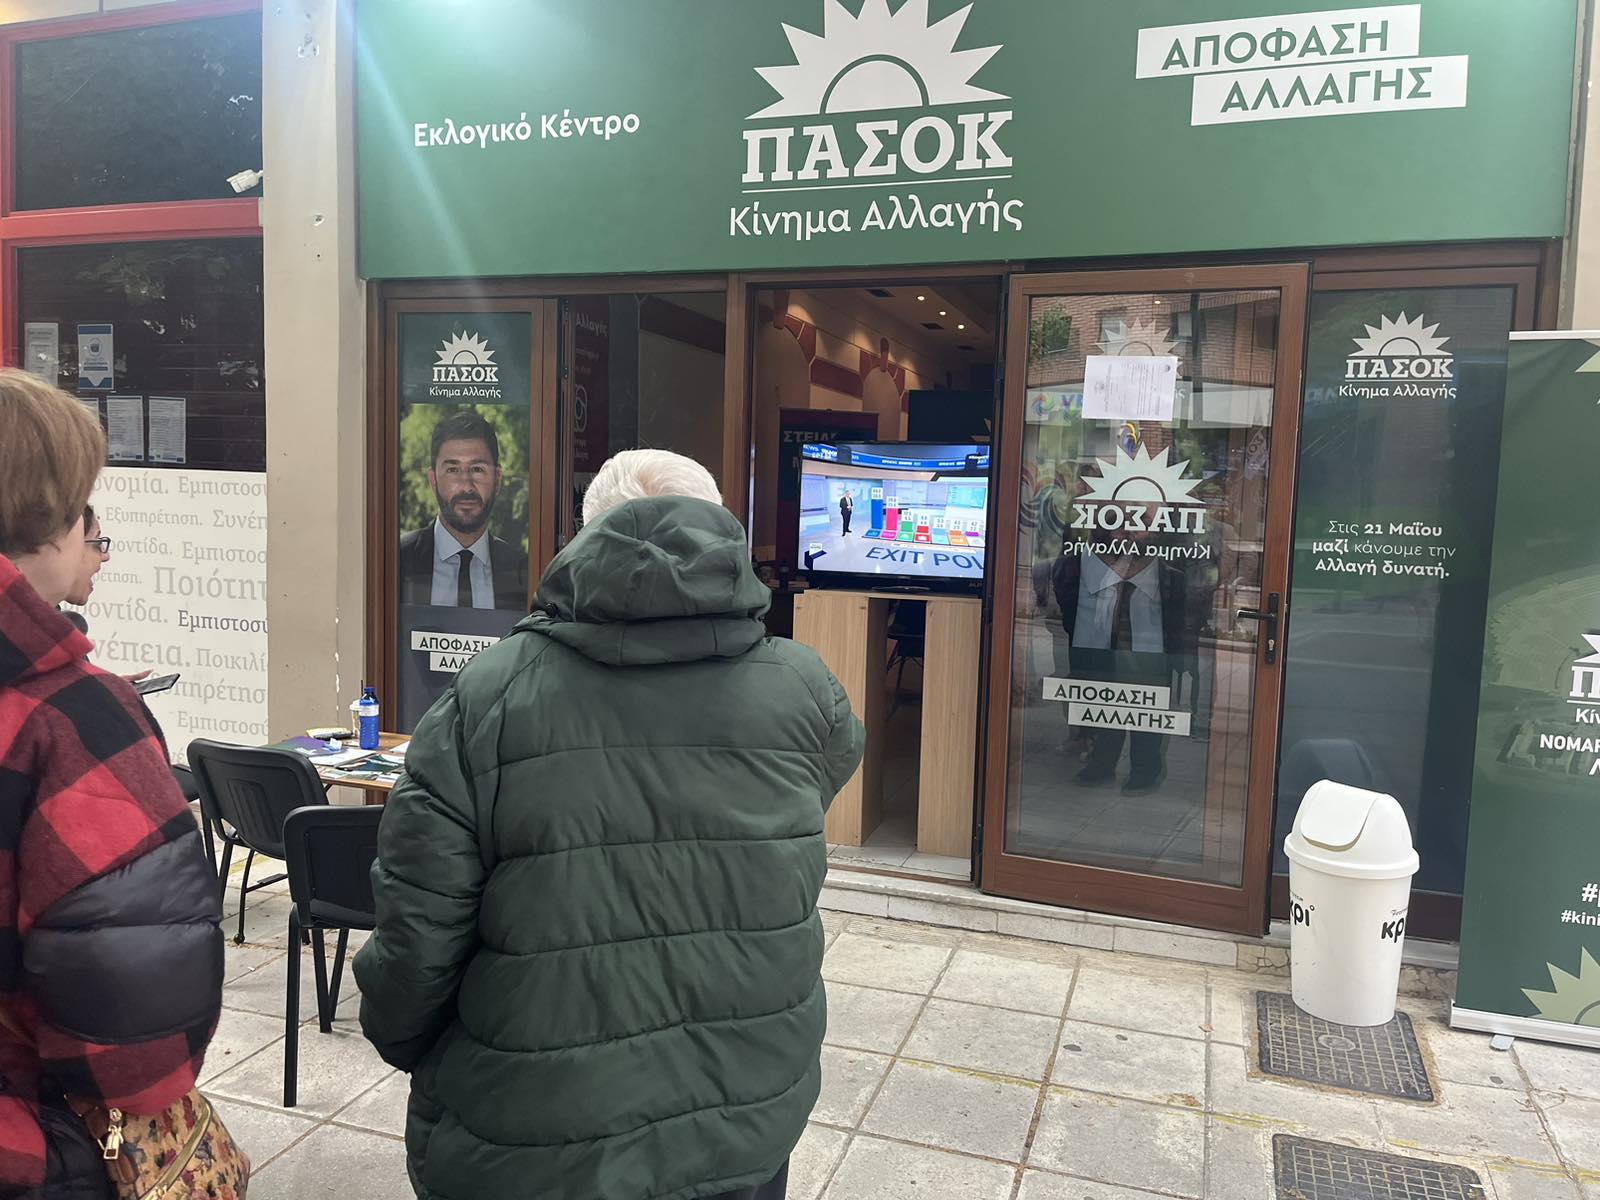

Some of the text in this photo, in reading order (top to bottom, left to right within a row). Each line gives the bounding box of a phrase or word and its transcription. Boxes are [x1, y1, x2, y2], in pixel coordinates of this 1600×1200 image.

[1161, 20, 1389, 70] ΑΠΟΦΑΣΗ
[1219, 66, 1433, 113] ΑΛΛΑΓΗΣ
[414, 109, 640, 149] Εκλογικό Κέντρο
[742, 110, 1013, 183] ΠΑΣΟΚ
[730, 188, 1025, 241] Κίνημα Αλλαγής
[432, 366, 499, 382] ΠΑΣΟΚ
[1345, 358, 1455, 379] ΠΑΣΟΚ
[429, 386, 501, 398] Κίνημα Αλλαγής
[1338, 384, 1457, 399] Κίνημα Αλλαγής
[1328, 520, 1360, 536] Στις
[1364, 522, 1383, 535] 21
[865, 547, 924, 563] EXIT
[1312, 539, 1457, 559] μαζί κάνουμε την
[1315, 558, 1450, 579] Αλλαγή δυνατή.
[420, 636, 490, 653] ΑΠΟΦΑΣΗ
[439, 655, 475, 669] ΑΛΛ
[1054, 684, 1156, 706] ΑΠΟΦΑΣΗ
[1081, 707, 1175, 729] ΑΛΛΑΓΗΣ
